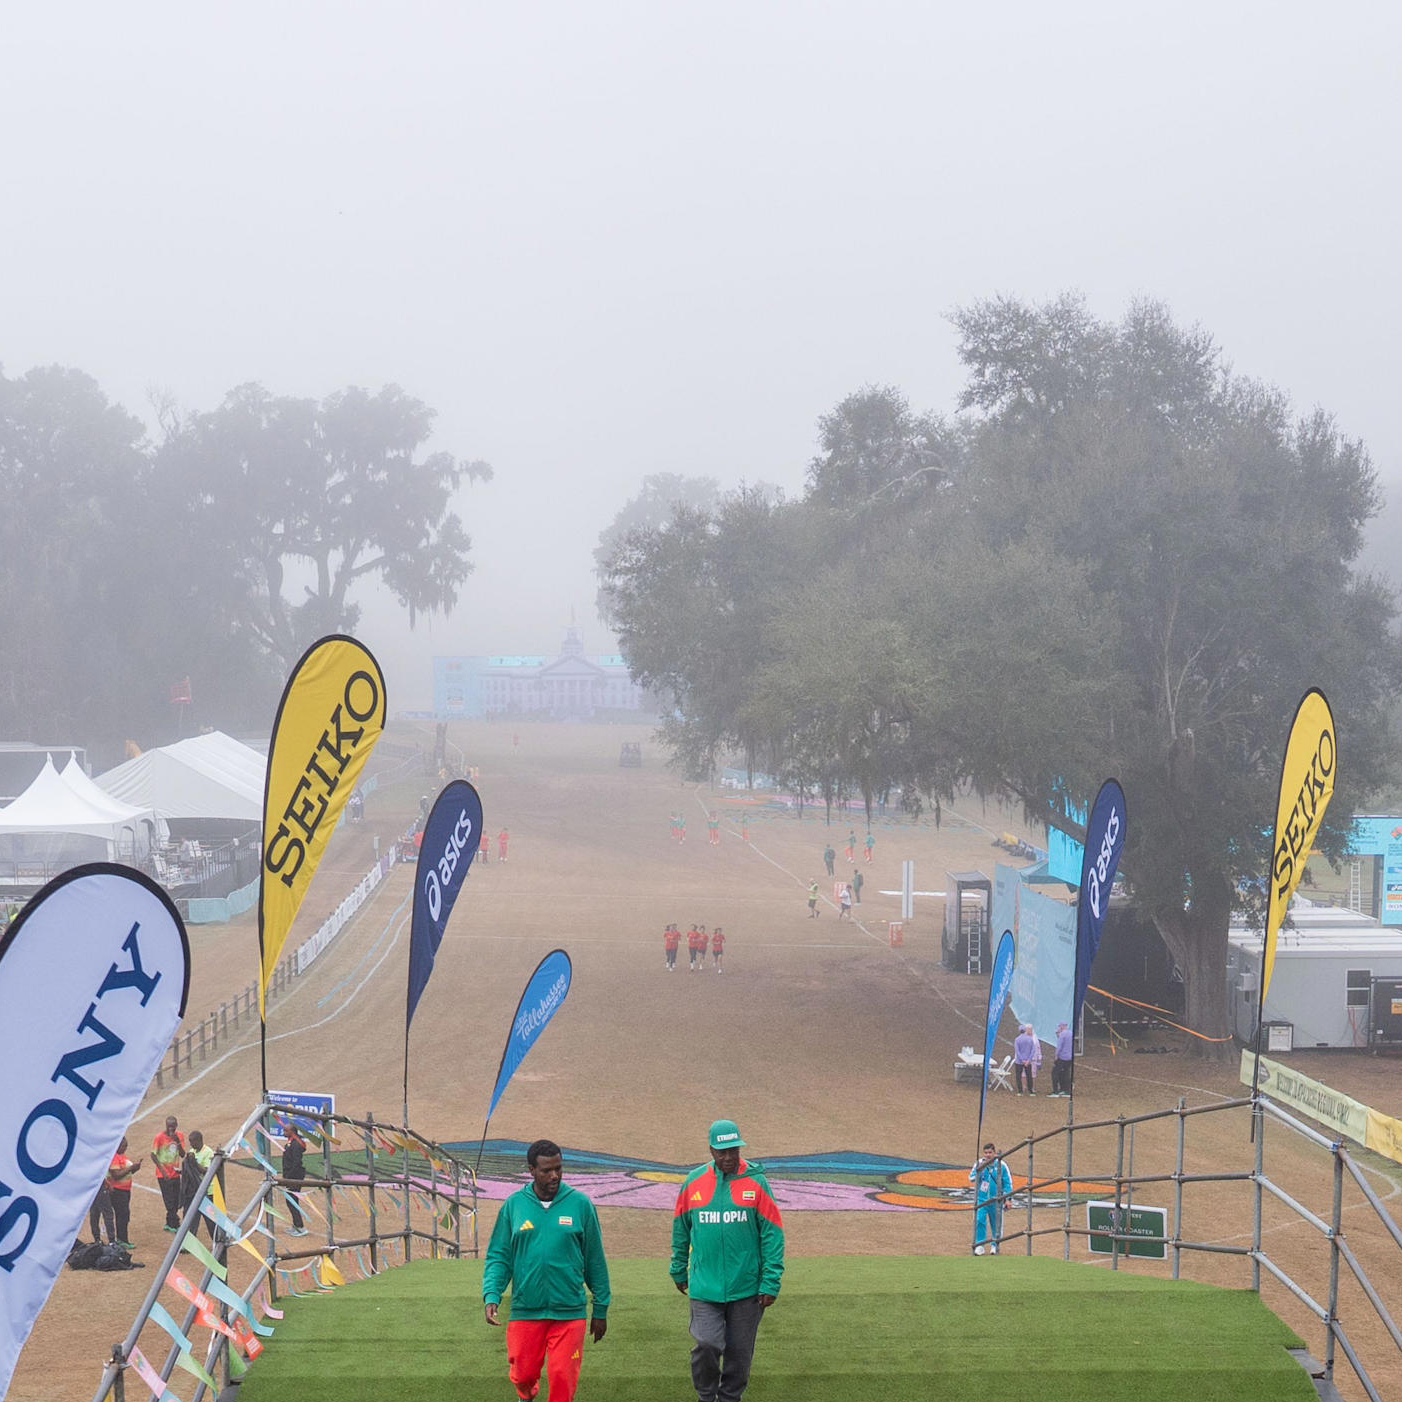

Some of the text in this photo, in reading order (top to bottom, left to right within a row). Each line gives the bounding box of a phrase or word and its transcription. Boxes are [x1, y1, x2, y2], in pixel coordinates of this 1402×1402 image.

[265, 671, 378, 887] SEIKO
[1274, 729, 1334, 900] SEIKO
[438, 809, 472, 886] asics
[517, 974, 566, 1040] Tallahassee
